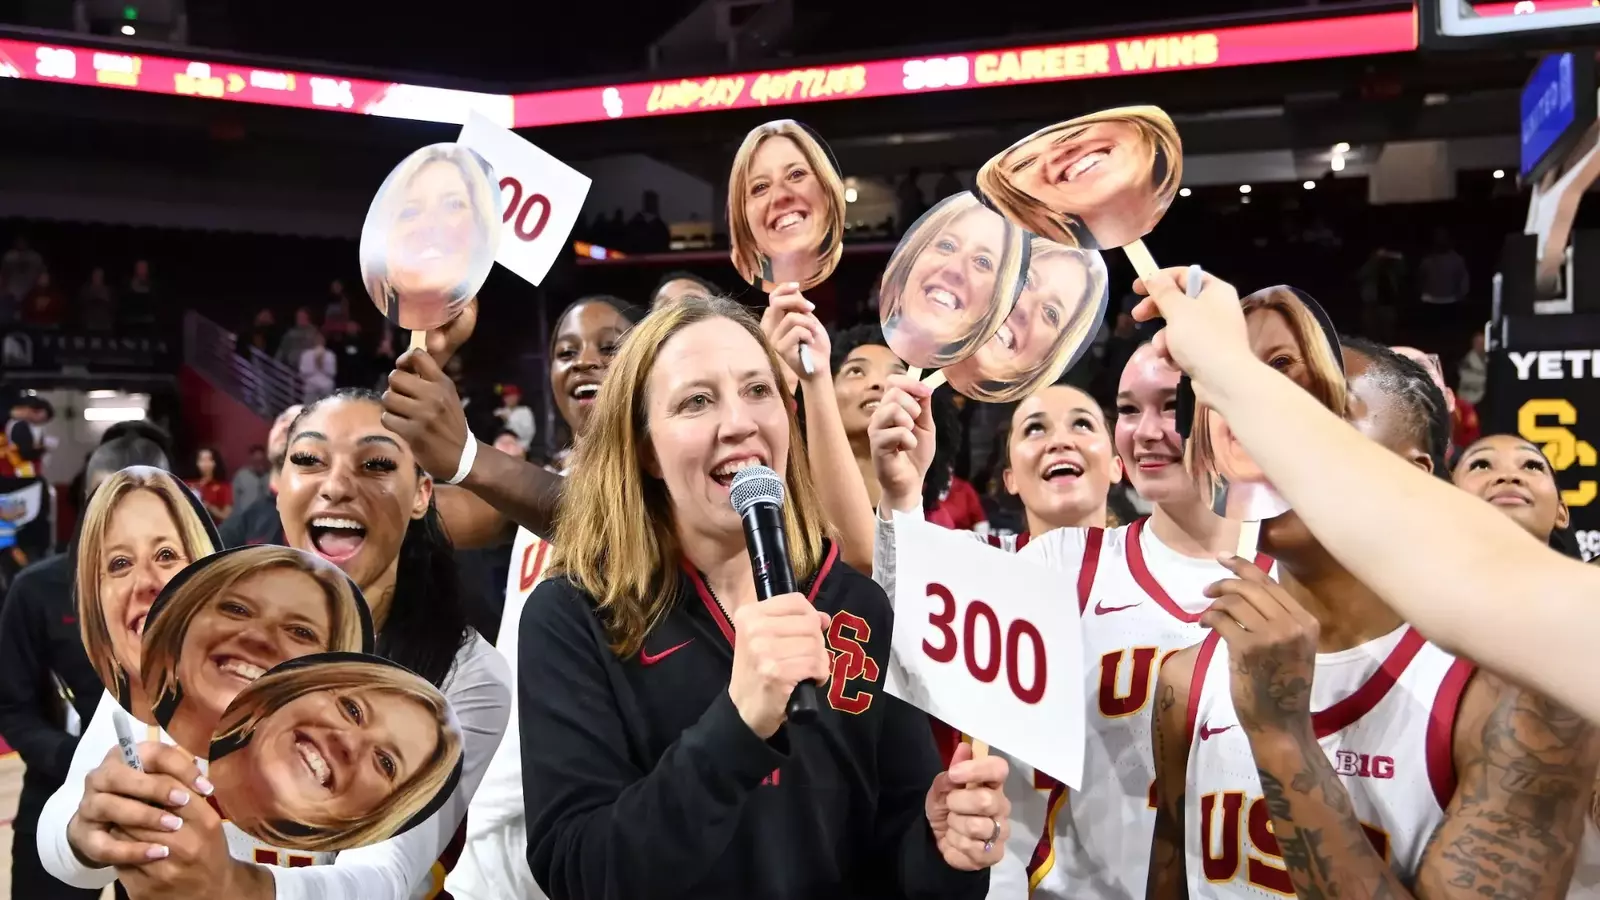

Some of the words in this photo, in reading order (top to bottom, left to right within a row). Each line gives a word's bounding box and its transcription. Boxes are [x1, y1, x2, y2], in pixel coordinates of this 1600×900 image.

[975, 44, 1110, 83] CAREER
[1116, 34, 1219, 70] WINS
[498, 176, 552, 242] 00
[825, 610, 880, 715] SC
[922, 582, 1047, 705] 300
